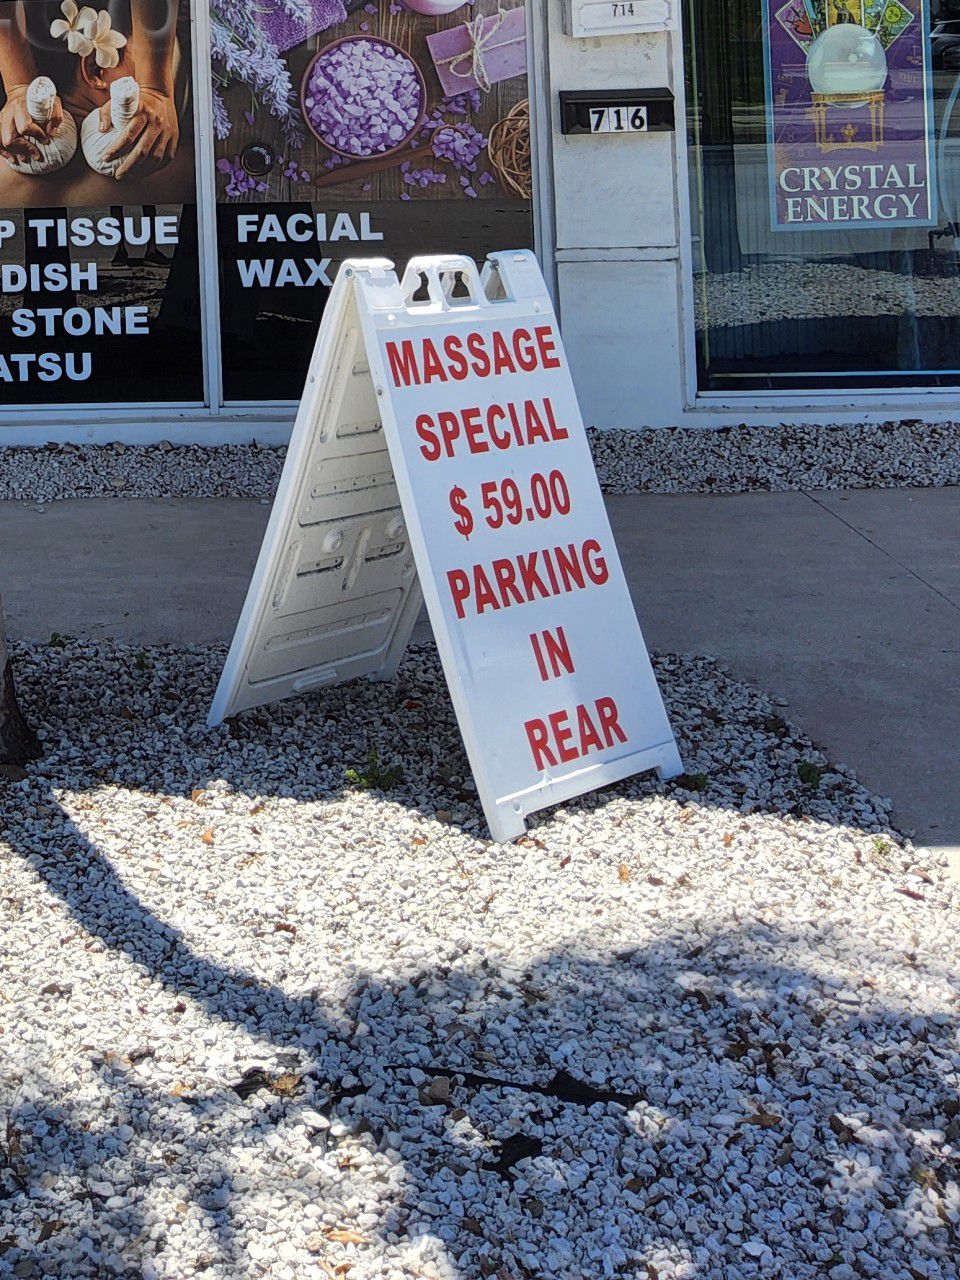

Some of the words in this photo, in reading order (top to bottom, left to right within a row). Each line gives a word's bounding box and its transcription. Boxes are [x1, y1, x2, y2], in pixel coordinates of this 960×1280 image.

[612, 3, 634, 17] 714
[592, 108, 645, 131] 716
[779, 163, 924, 192] CRYSTAL
[785, 193, 920, 222] ENERGY
[29, 216, 179, 248] TISSUE
[236, 212, 384, 243] FACIAL
[237, 258, 333, 287] WAX
[12, 306, 150, 337] STONE
[385, 325, 562, 387] MASSAGE
[415, 397, 570, 462] SPECIAL
[449, 484, 474, 542] $
[482, 469, 571, 530] 59.00
[447, 539, 610, 619] PARKING
[530, 627, 576, 682] IN
[524, 696, 628, 772] REAR
